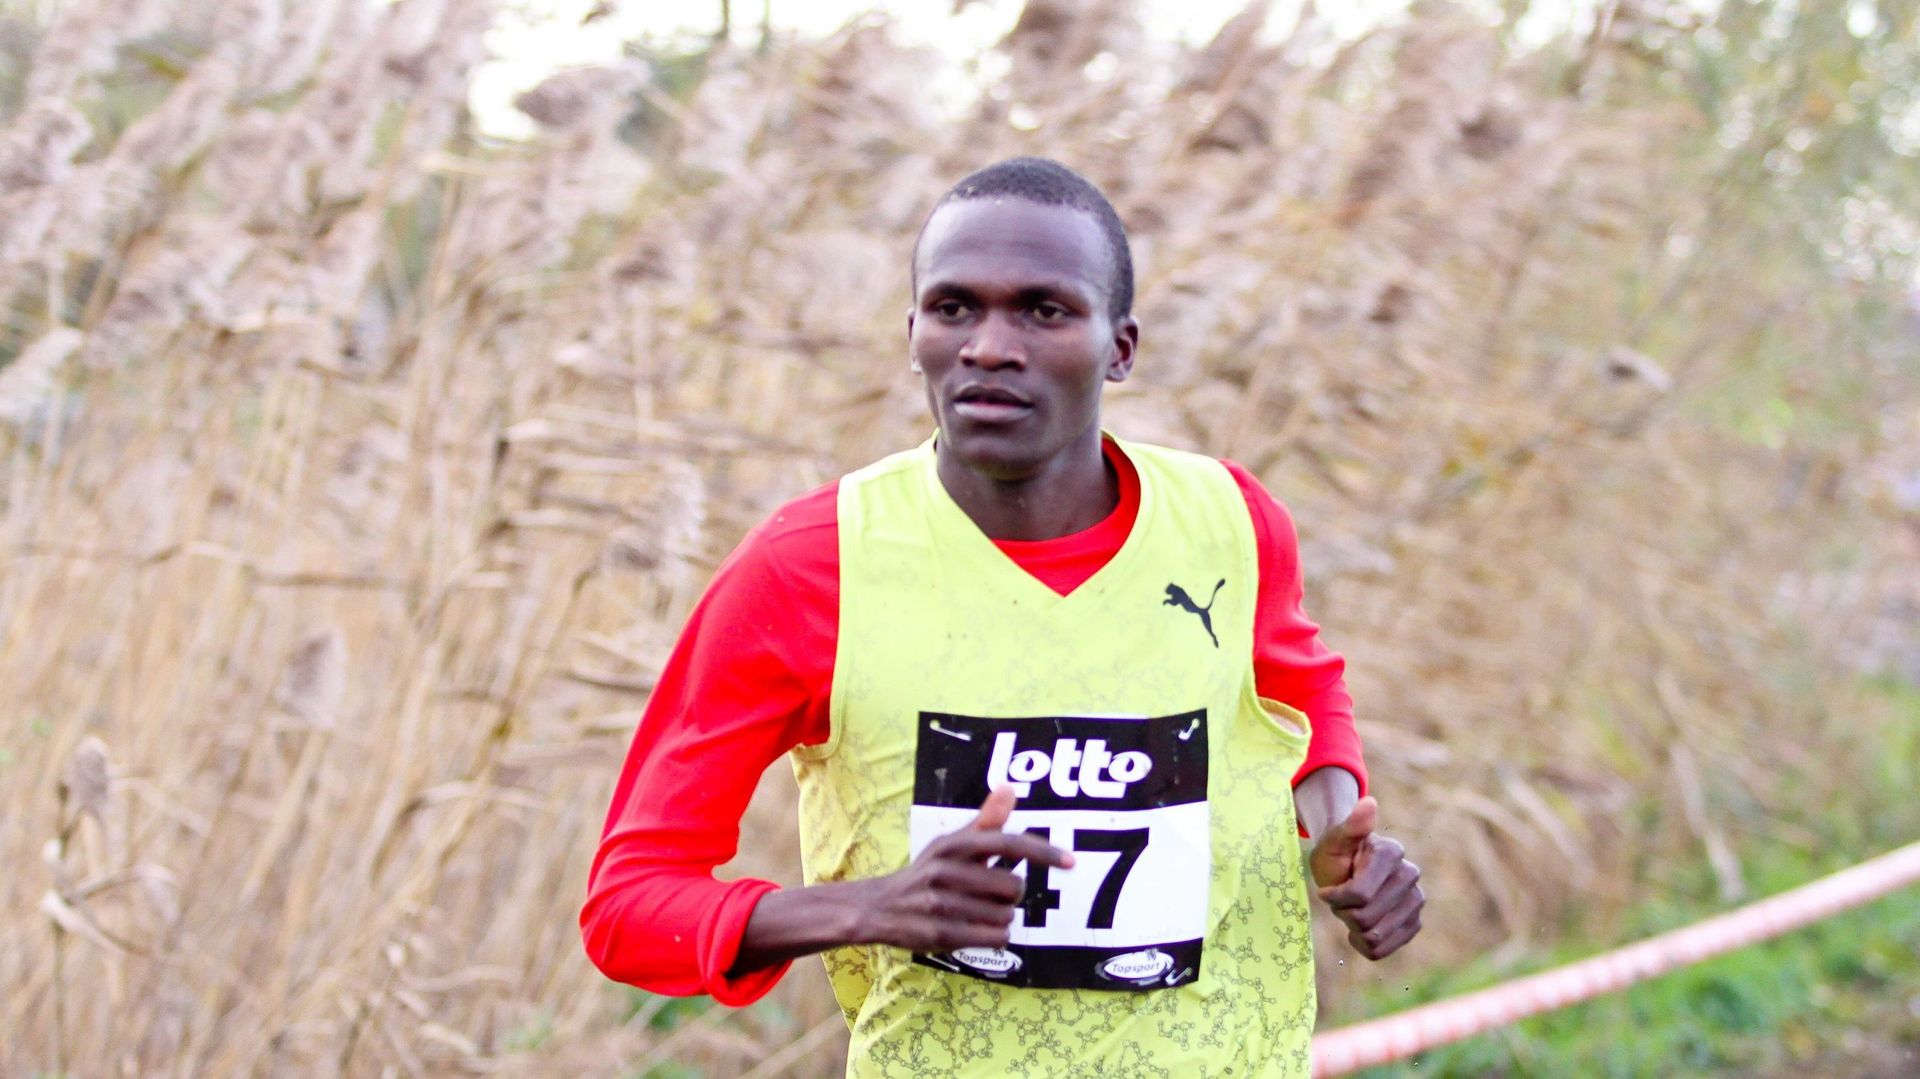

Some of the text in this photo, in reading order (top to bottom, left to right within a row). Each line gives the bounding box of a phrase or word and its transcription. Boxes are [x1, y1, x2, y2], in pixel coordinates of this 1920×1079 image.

[987, 732, 1152, 798] lotto
[990, 827, 1150, 929] 47
[959, 951, 1008, 967] Topsport
[1112, 962, 1160, 973] Topsport
